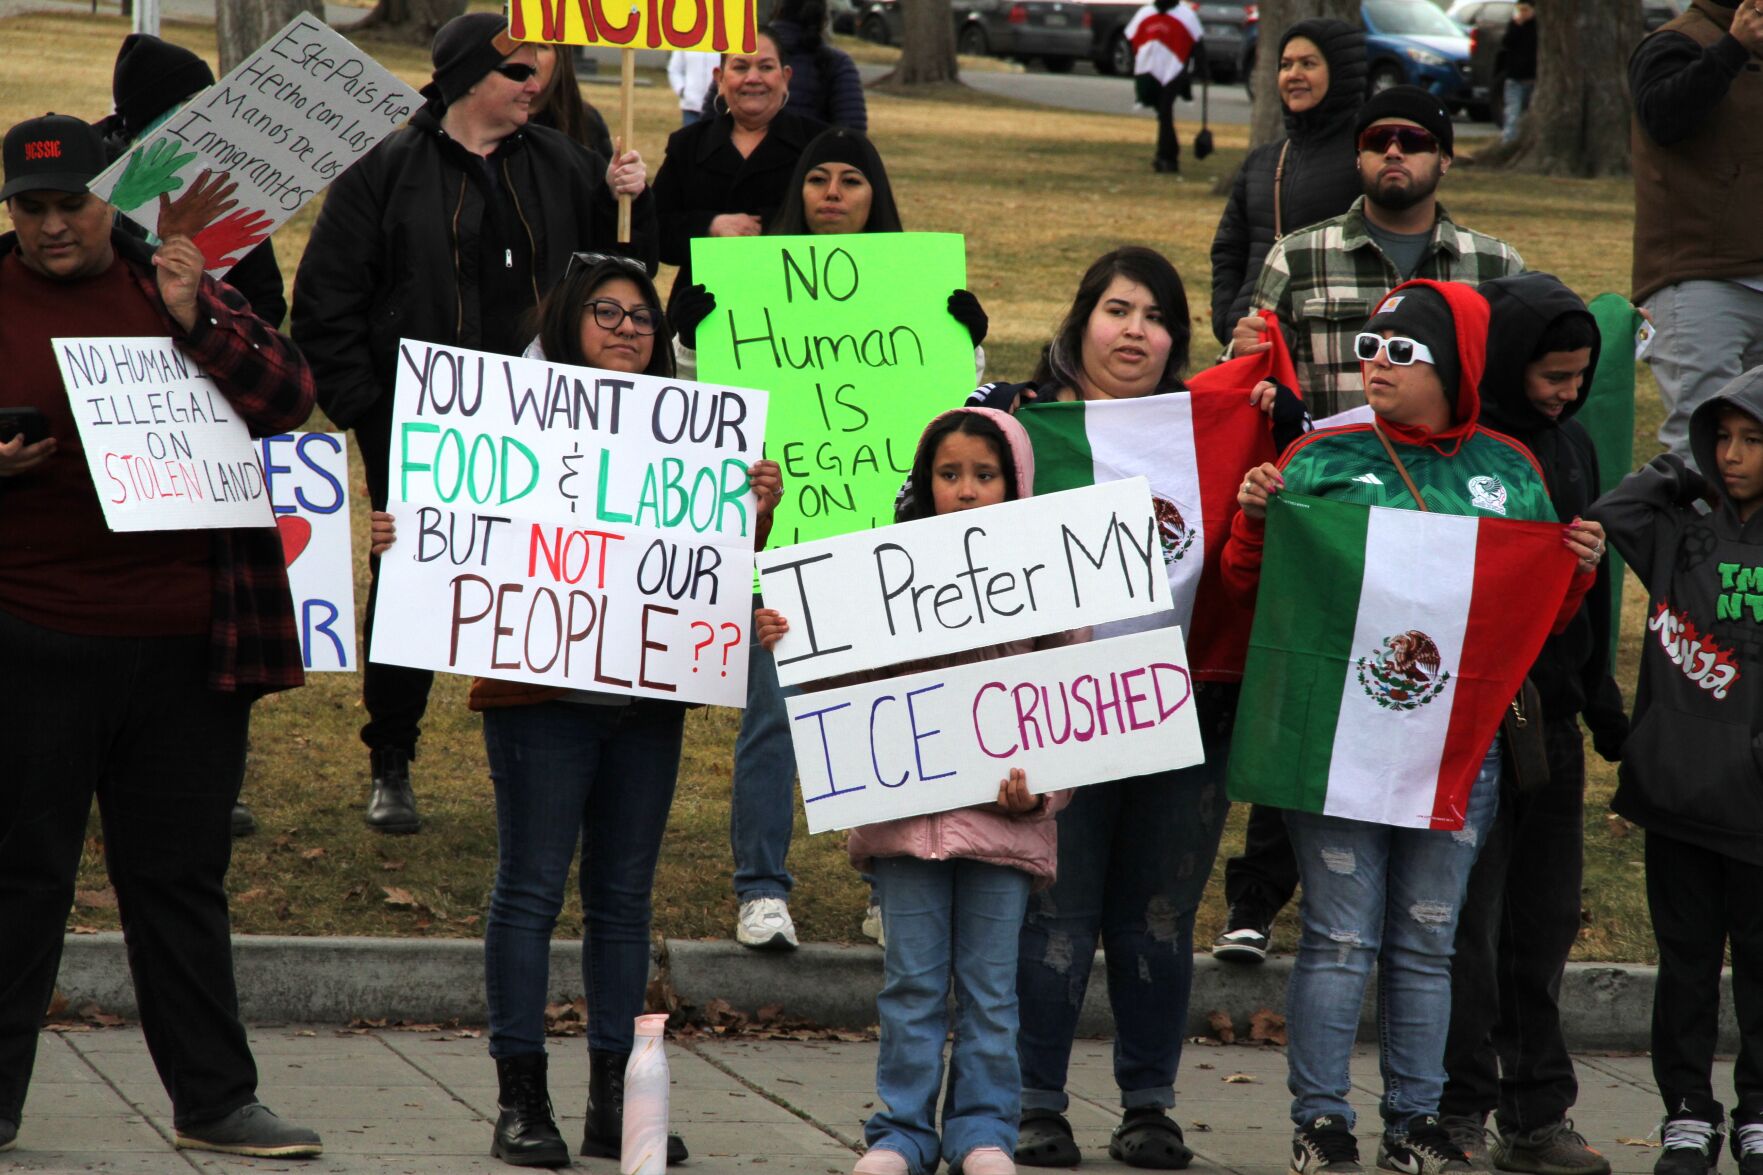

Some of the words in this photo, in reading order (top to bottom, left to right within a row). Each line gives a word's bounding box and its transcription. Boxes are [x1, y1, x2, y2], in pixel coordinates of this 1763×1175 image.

[235, 56, 307, 109] Hecho
[338, 119, 376, 153] Las
[270, 22, 335, 77] Este
[371, 92, 410, 124] Fue
[166, 110, 315, 212] Inmigrantes
[207, 86, 294, 145] Manos
[289, 135, 315, 163] De
[311, 151, 343, 180] Los
[781, 245, 860, 303] NO
[64, 343, 107, 389] NO
[109, 344, 189, 384] HUMAN
[728, 307, 925, 370] Human
[87, 390, 228, 425] ILLEGAL
[400, 344, 484, 416] YOU
[503, 361, 635, 432] WANT
[651, 386, 748, 452] OUR
[815, 382, 870, 433] IS
[105, 452, 204, 504] STOLEN
[203, 459, 263, 502] LAND
[147, 430, 193, 460] ON
[252, 432, 344, 514] ES
[401, 422, 540, 505] FOOD
[596, 448, 752, 537] LABOR
[799, 483, 857, 518] ON
[413, 507, 512, 566] BUT
[527, 523, 625, 589] NOT
[636, 538, 722, 605] OUR
[761, 552, 853, 666] I
[873, 527, 1045, 636] Prefer
[1061, 511, 1155, 607] MY
[794, 683, 957, 803] ICE
[973, 662, 1191, 759] CRUSHED
